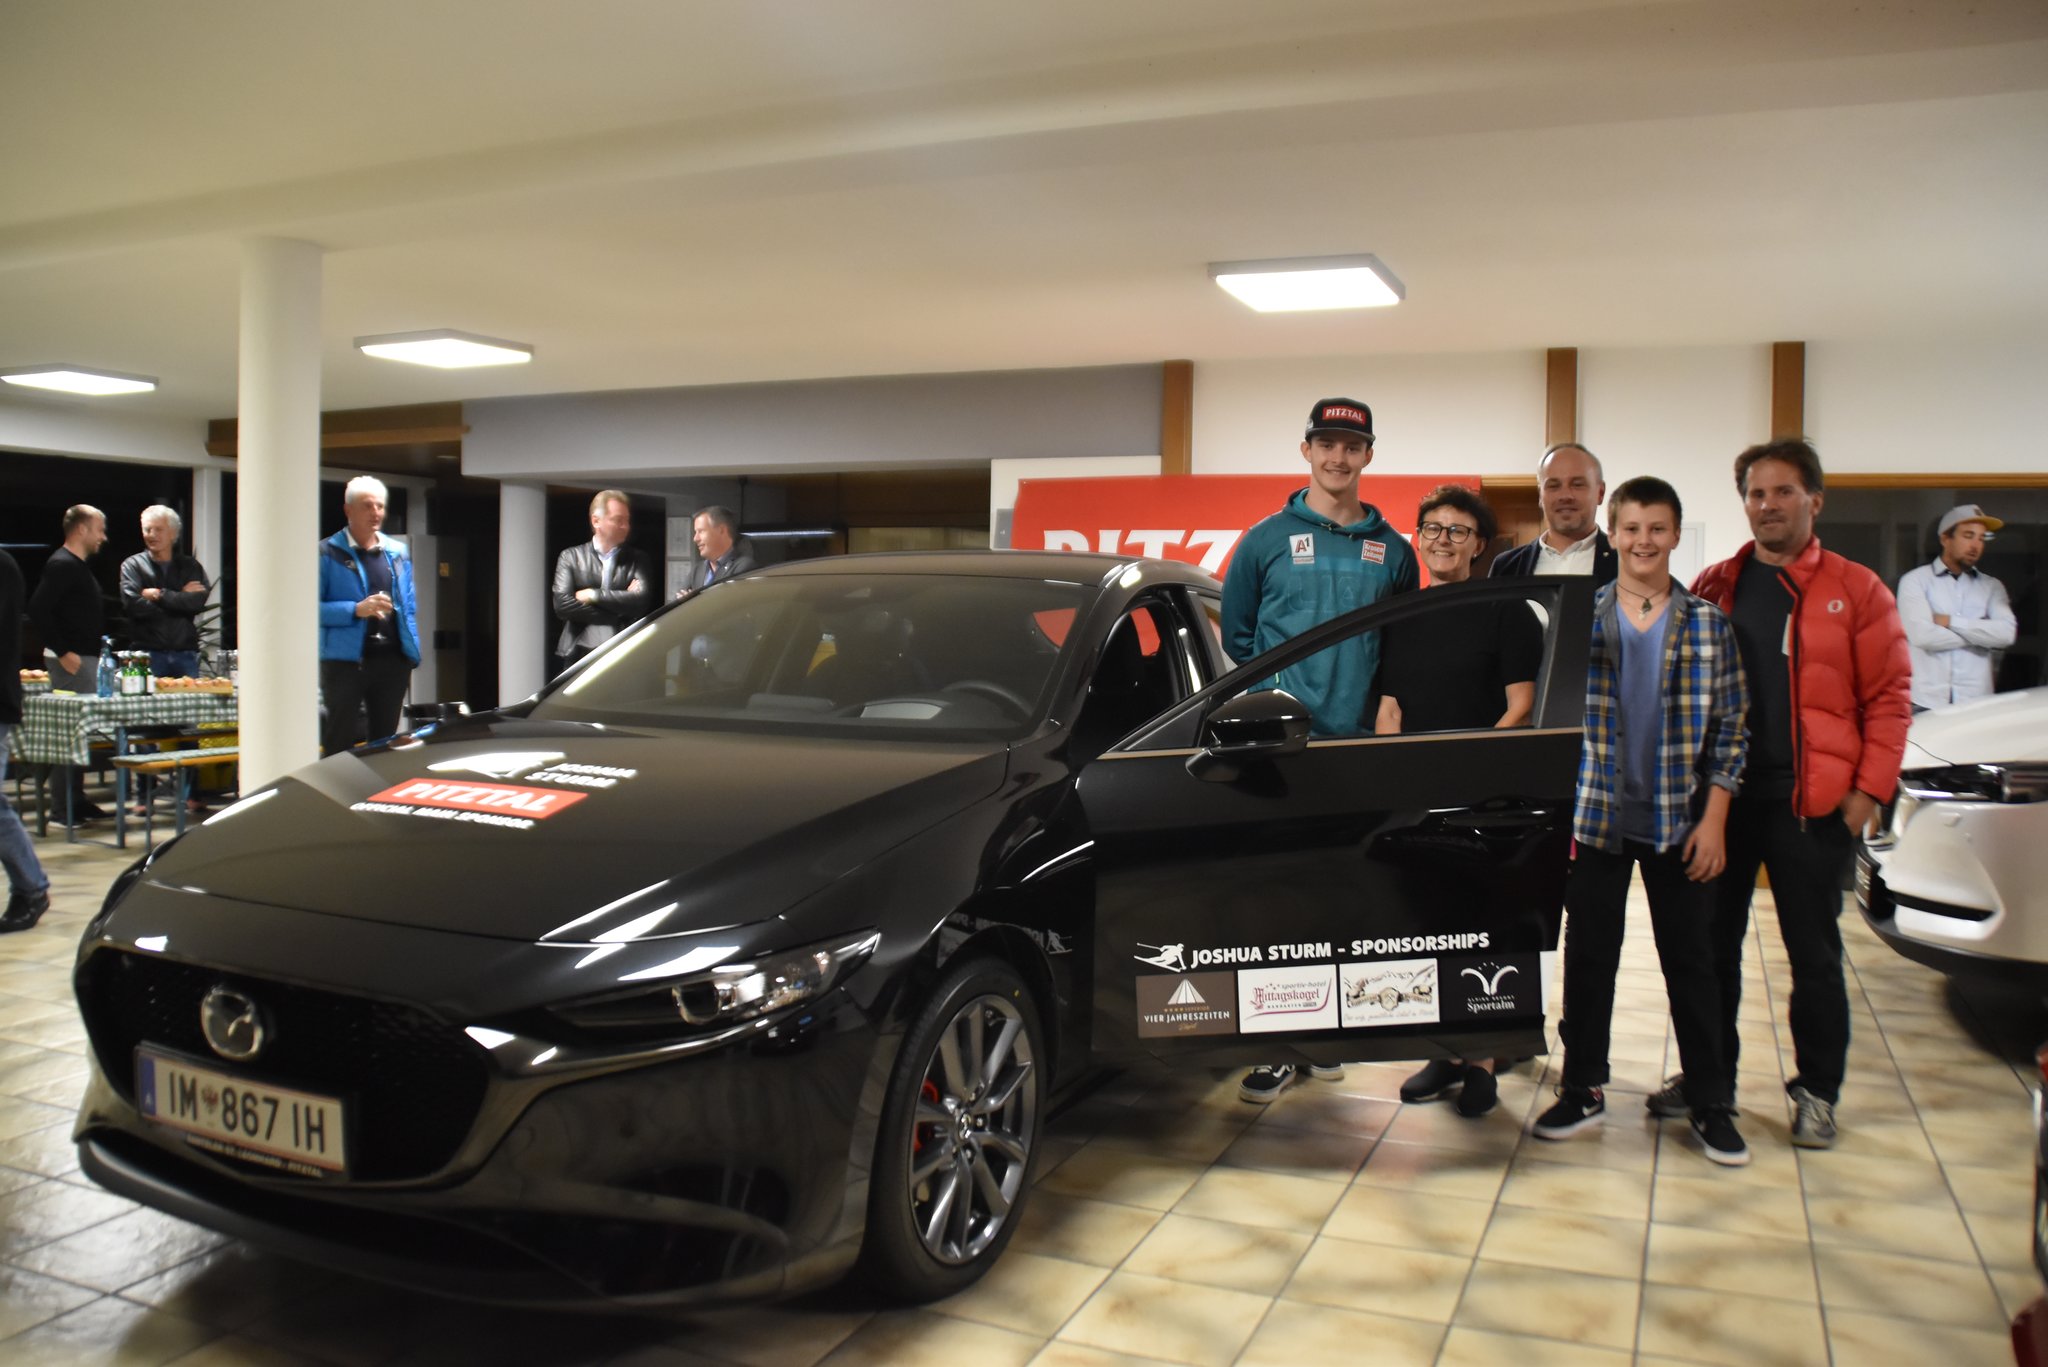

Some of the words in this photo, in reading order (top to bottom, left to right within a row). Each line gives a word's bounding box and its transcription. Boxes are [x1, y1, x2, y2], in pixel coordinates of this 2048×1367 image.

[1325, 407, 1364, 421] PITZTAL
[524, 771, 618, 789] STURM
[392, 782, 557, 812] PITZTAL
[1191, 946, 1263, 968] JOSHUA
[1268, 941, 1332, 961] STURM
[1351, 932, 1490, 956] SPONSORSHIPS
[1467, 1000, 1516, 1014] Sportalm
[1144, 1014, 1165, 1024] VIER
[1166, 1010, 1231, 1024] JAHRESZEITEN
[169, 1072, 198, 1122] IM
[221, 1087, 281, 1141] 867
[291, 1102, 326, 1154] IH
